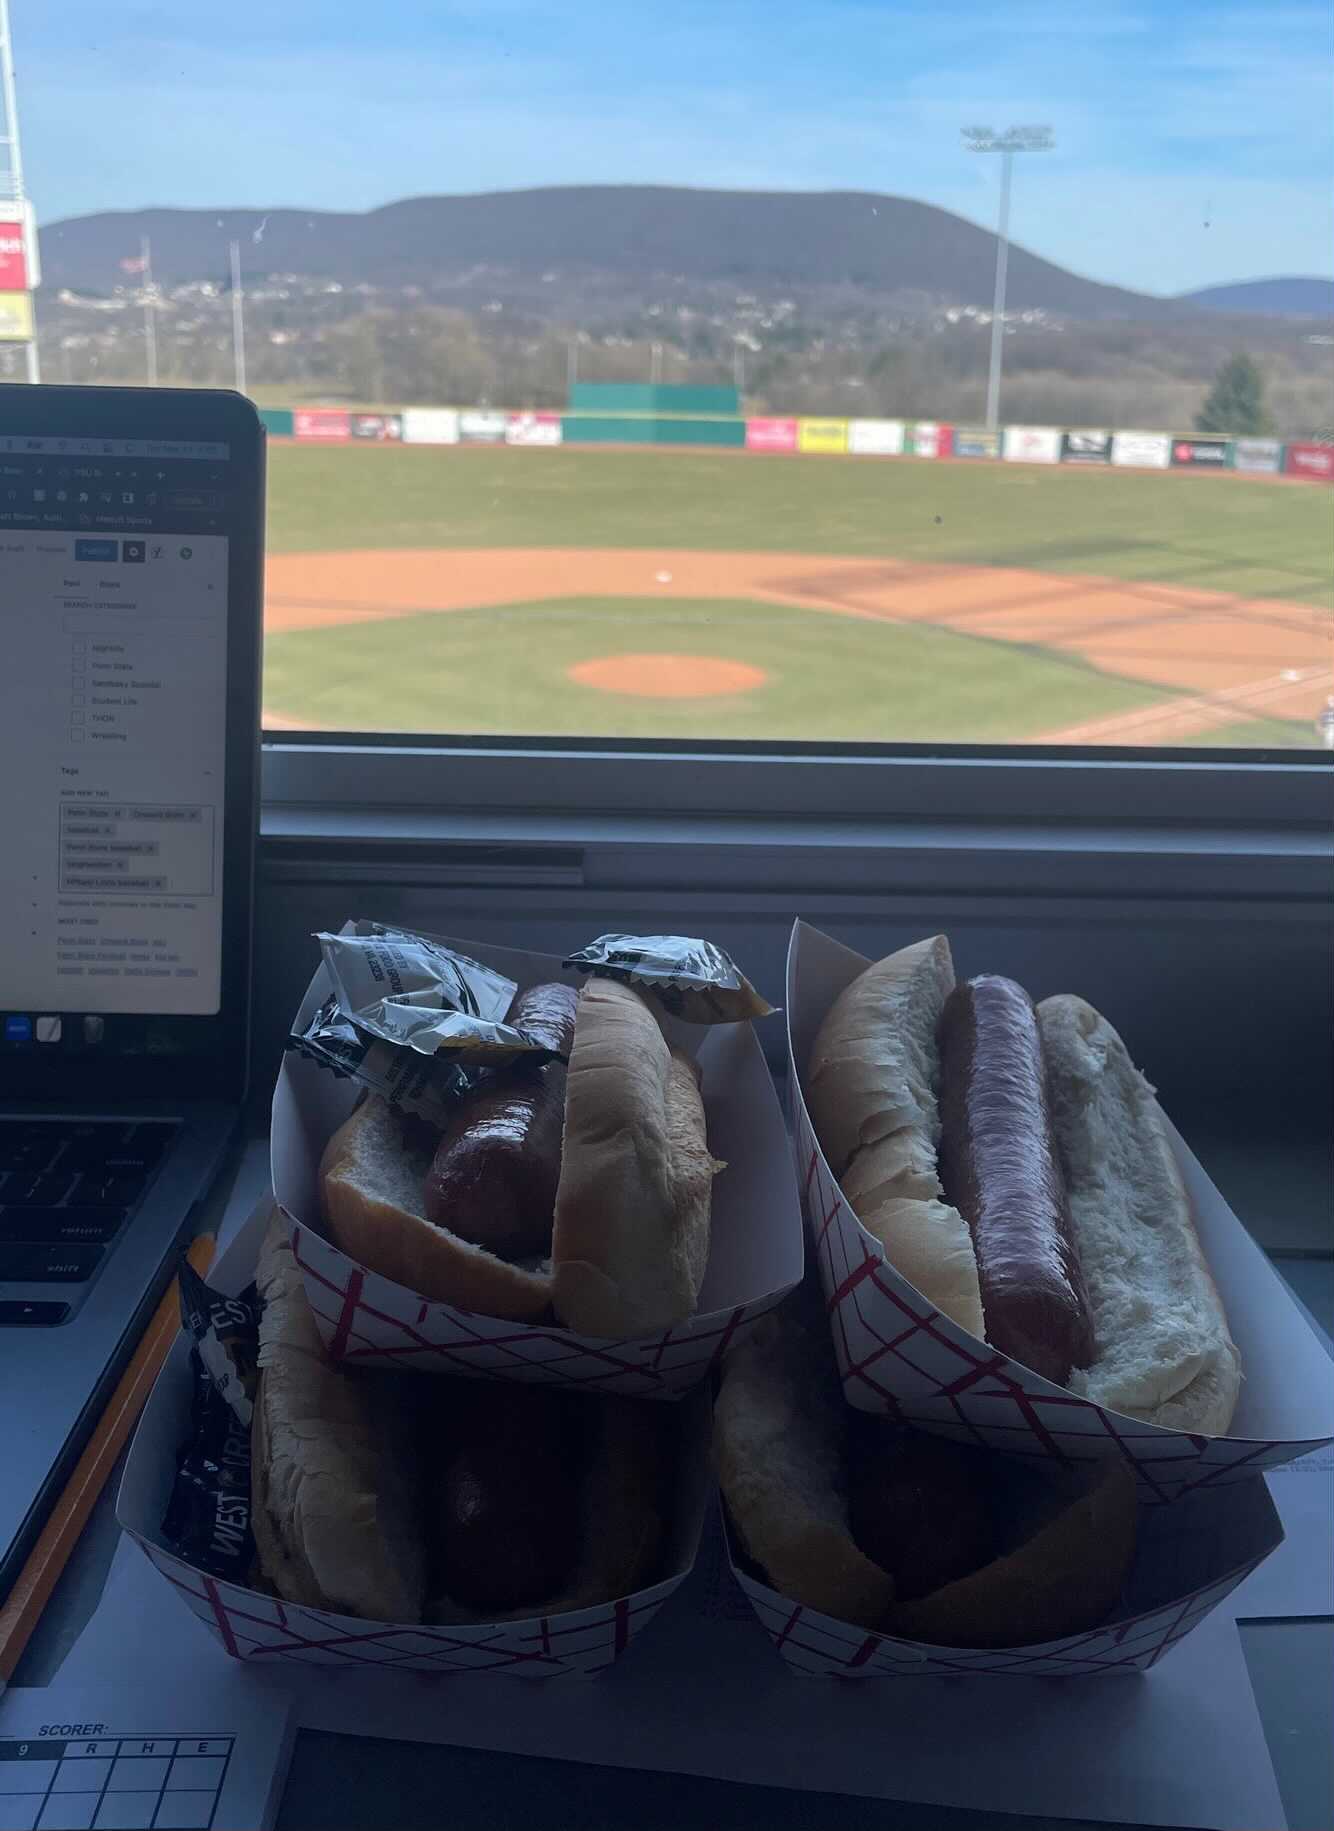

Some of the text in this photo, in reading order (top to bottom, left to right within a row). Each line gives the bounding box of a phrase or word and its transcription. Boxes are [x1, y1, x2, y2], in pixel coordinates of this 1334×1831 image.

[209, 1491, 249, 1557] WEST
[38, 1723, 109, 1737] SCORER:
[18, 1741, 209, 1756] 9 R H E
